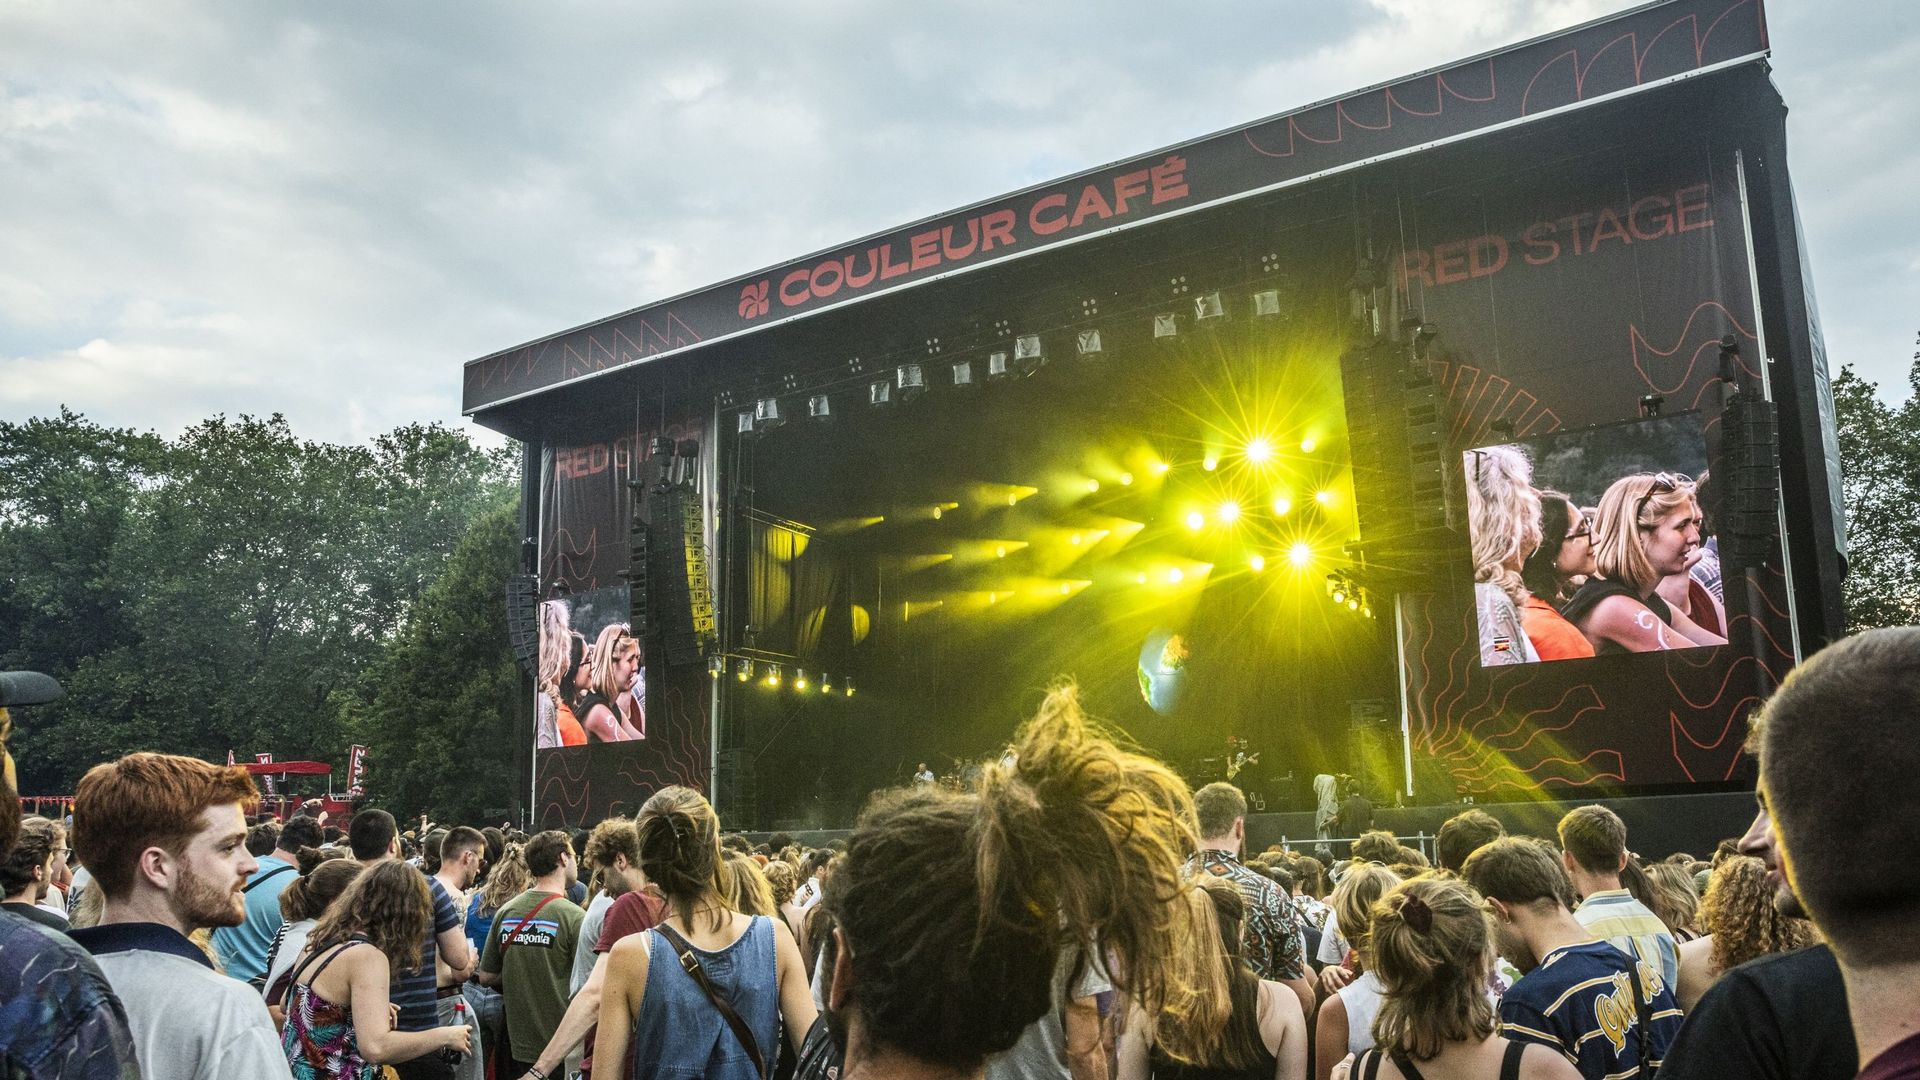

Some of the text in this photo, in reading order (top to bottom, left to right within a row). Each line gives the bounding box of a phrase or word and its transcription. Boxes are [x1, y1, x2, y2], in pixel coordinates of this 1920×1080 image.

[779, 155, 1189, 307] COULEUR CAFÉ
[1397, 184, 1714, 290] RED STAGE
[555, 443, 608, 479] RED
[502, 932, 550, 946] ptagonia
